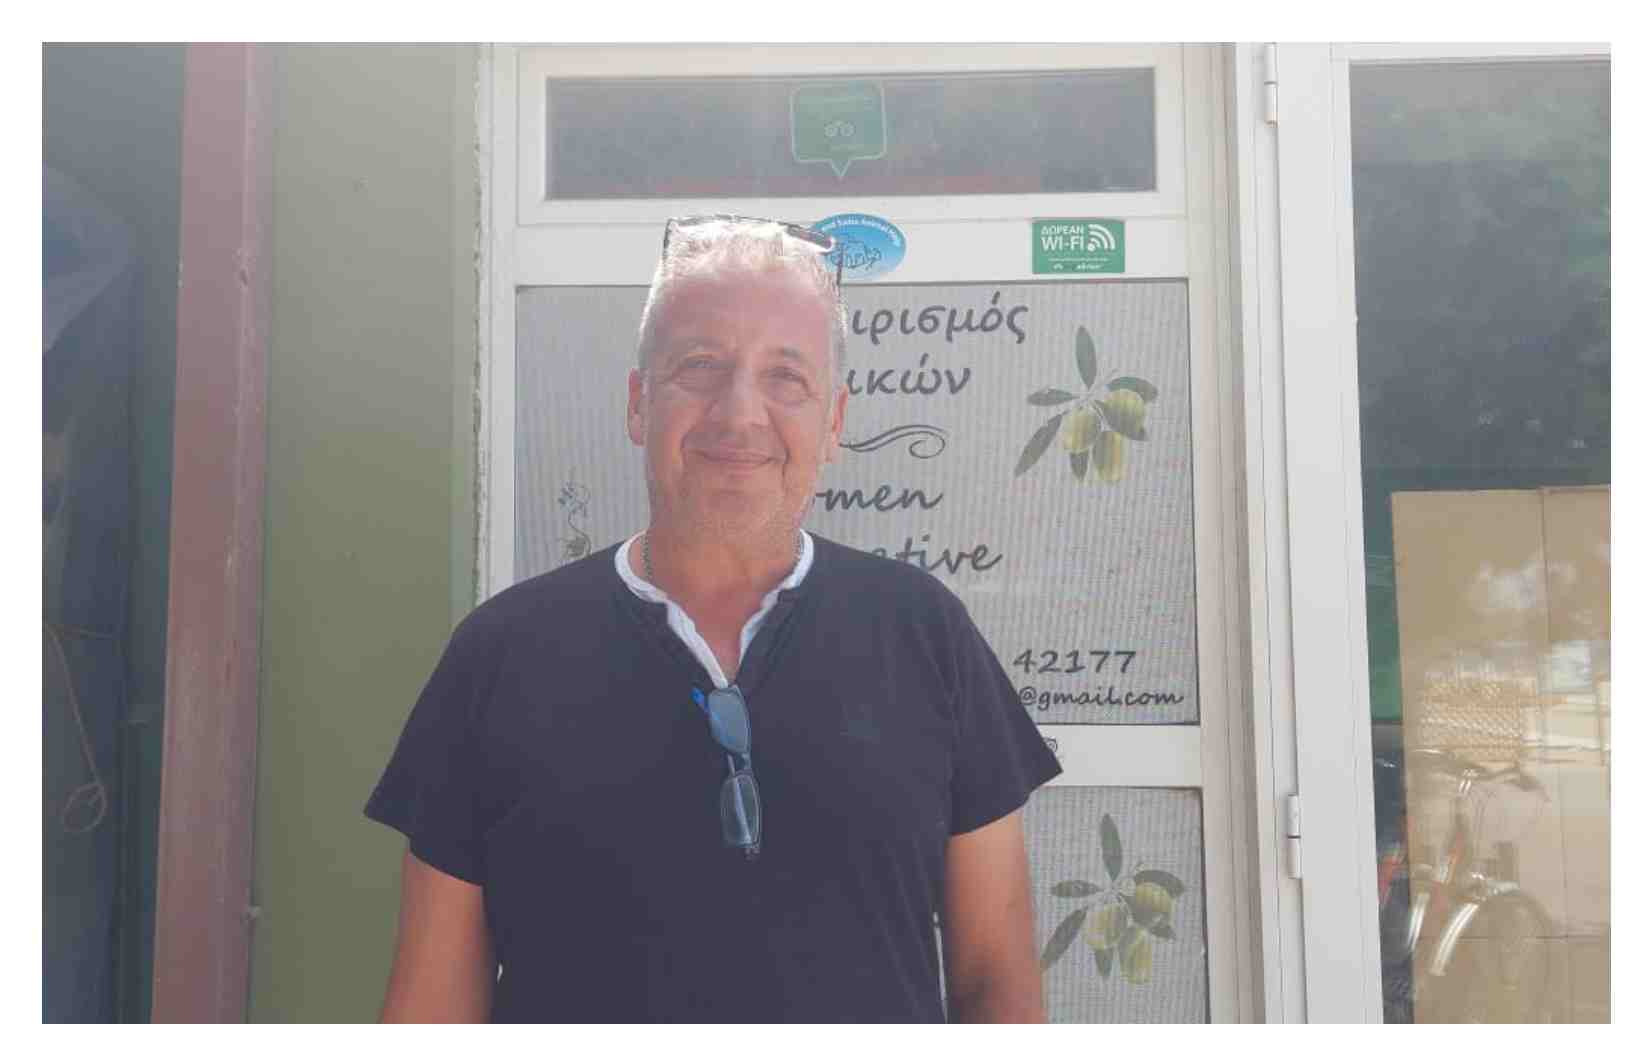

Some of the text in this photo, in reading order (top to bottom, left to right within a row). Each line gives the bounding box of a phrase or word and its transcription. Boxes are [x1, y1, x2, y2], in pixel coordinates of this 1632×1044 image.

[852, 290, 1028, 345] ιρισμός
[846, 353, 971, 395] ικών
[817, 484, 943, 512] men
[1013, 649, 1137, 673] 42177
